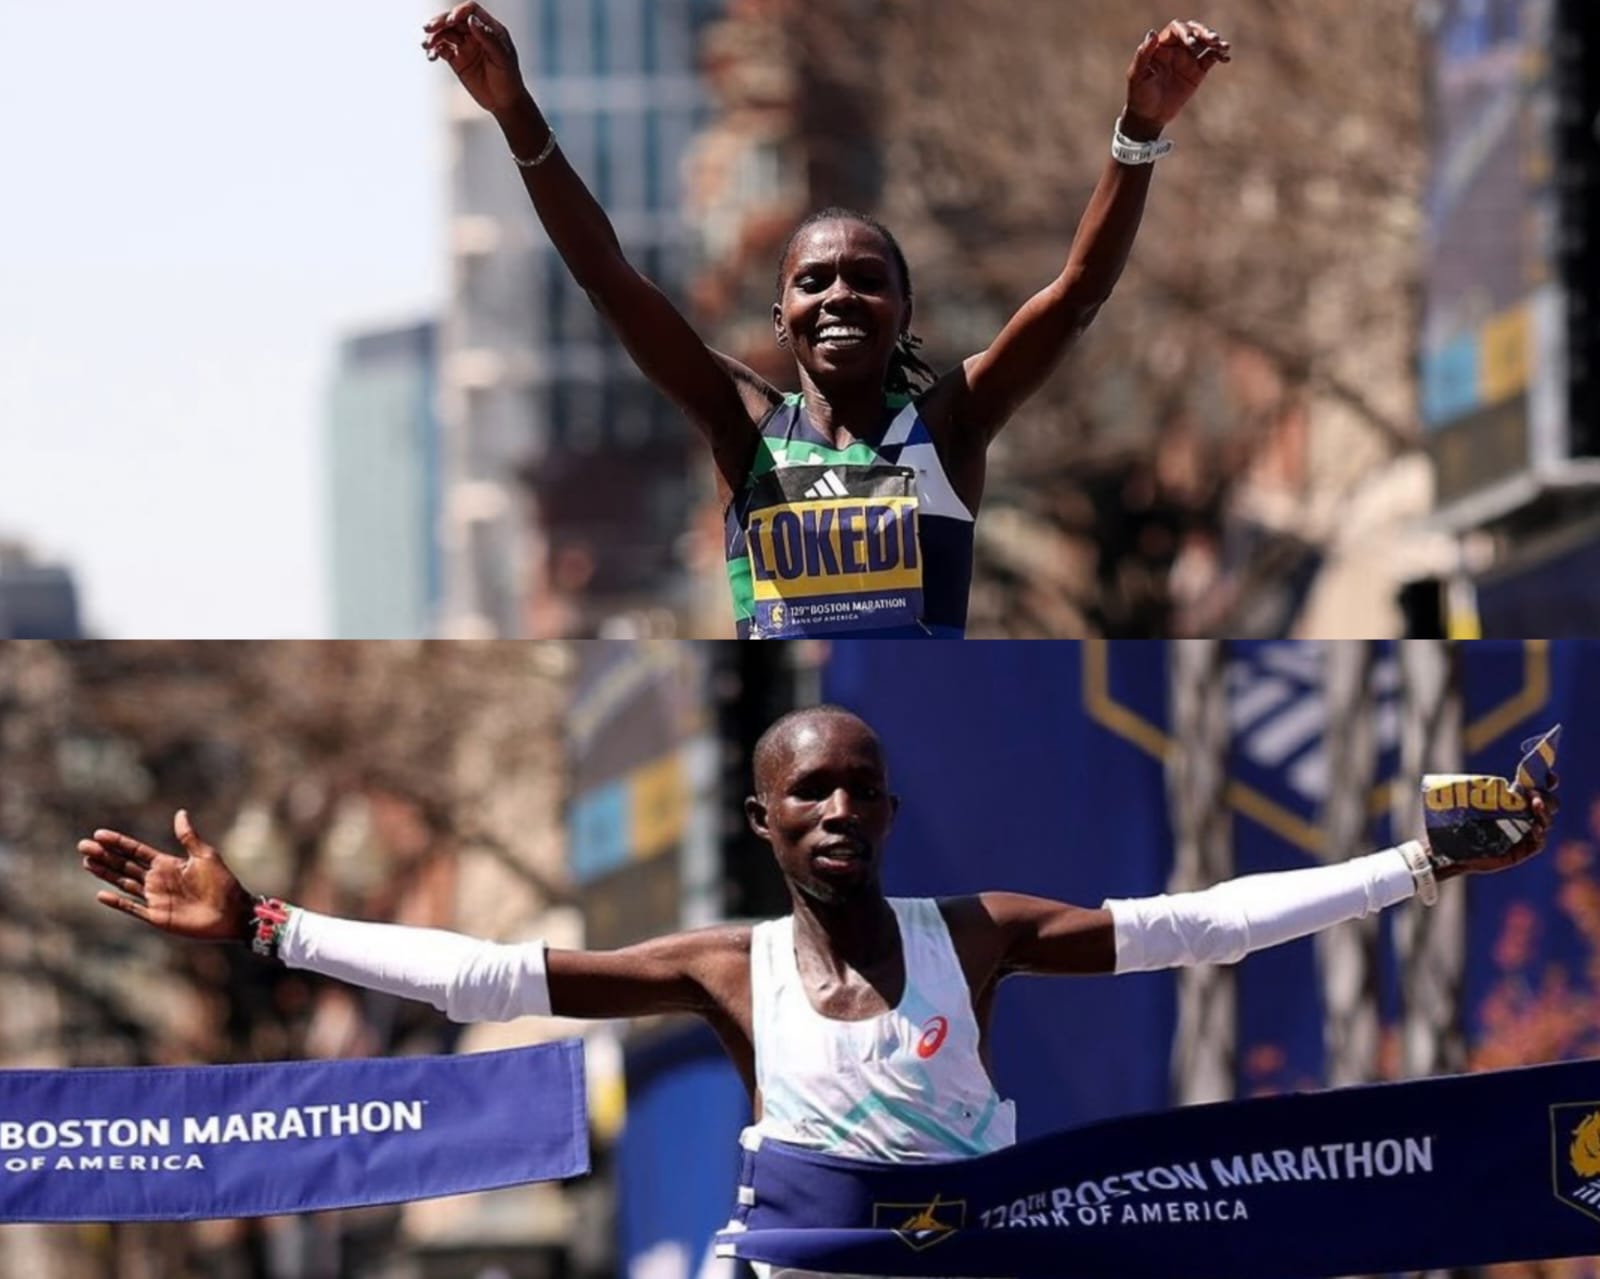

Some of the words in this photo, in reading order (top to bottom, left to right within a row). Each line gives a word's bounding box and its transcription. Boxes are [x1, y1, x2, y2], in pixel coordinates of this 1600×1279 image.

[748, 503, 919, 582] LOKEDI
[811, 601, 851, 615] BOSTON
[852, 597, 907, 613] MARATHON
[791, 616, 812, 626] BANK
[813, 615, 823, 624] OF
[824, 613, 859, 623] AMERICA
[0, 1118, 170, 1150] BOSTON
[184, 1101, 423, 1144] MARATHON
[5, 1156, 46, 1172] OF
[54, 1153, 205, 1170] AMERICA
[1211, 1136, 1434, 1188] MARATHON
[1077, 1205, 1113, 1226] OF
[1121, 1200, 1249, 1224] AMERICA
